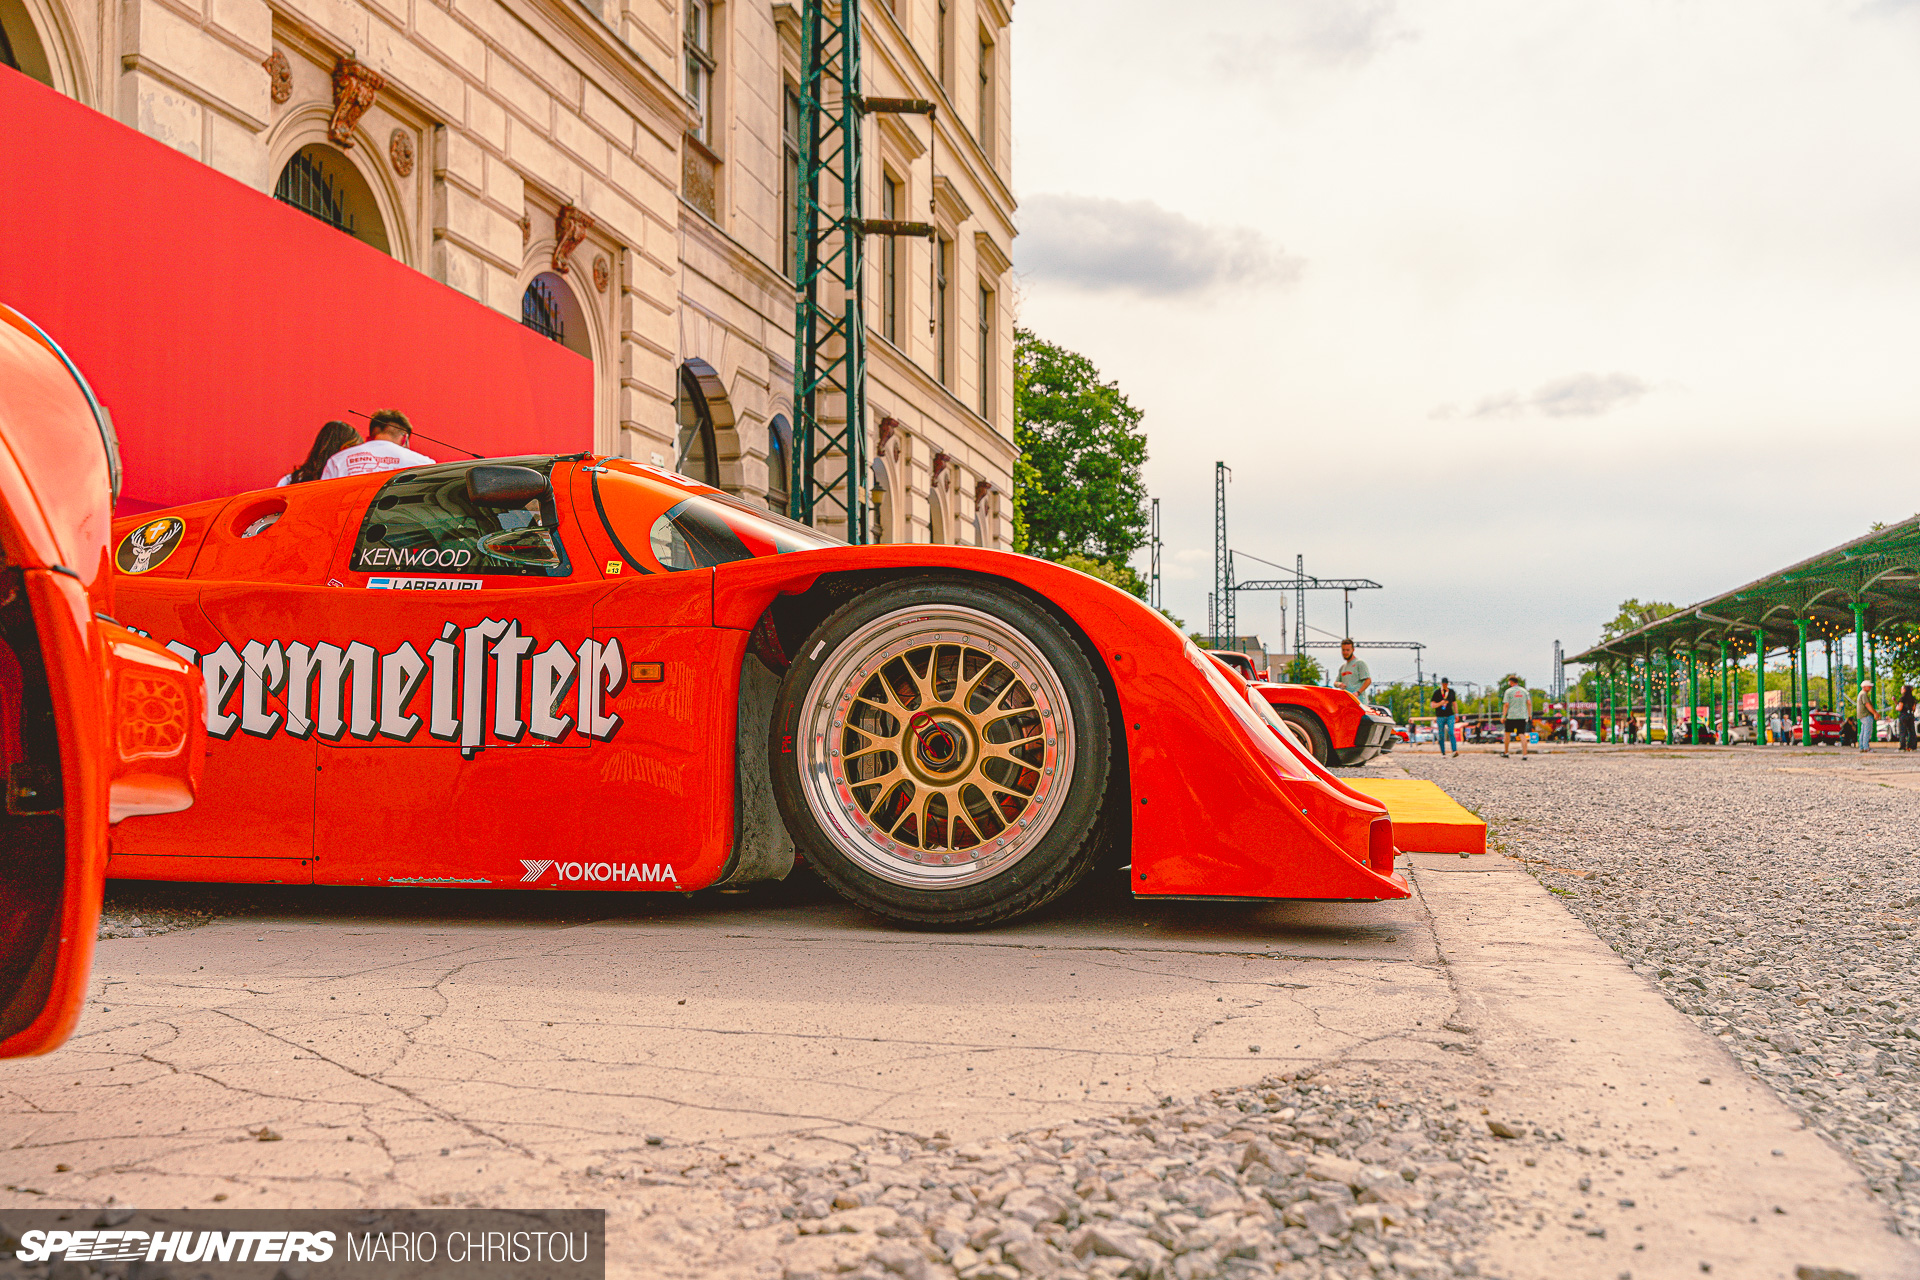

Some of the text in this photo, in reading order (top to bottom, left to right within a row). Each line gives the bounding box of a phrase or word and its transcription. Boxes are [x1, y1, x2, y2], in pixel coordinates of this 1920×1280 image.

[359, 548, 471, 567] KENWOOD
[127, 617, 627, 760] ermeister
[555, 861, 677, 882] YOKOHAMA
